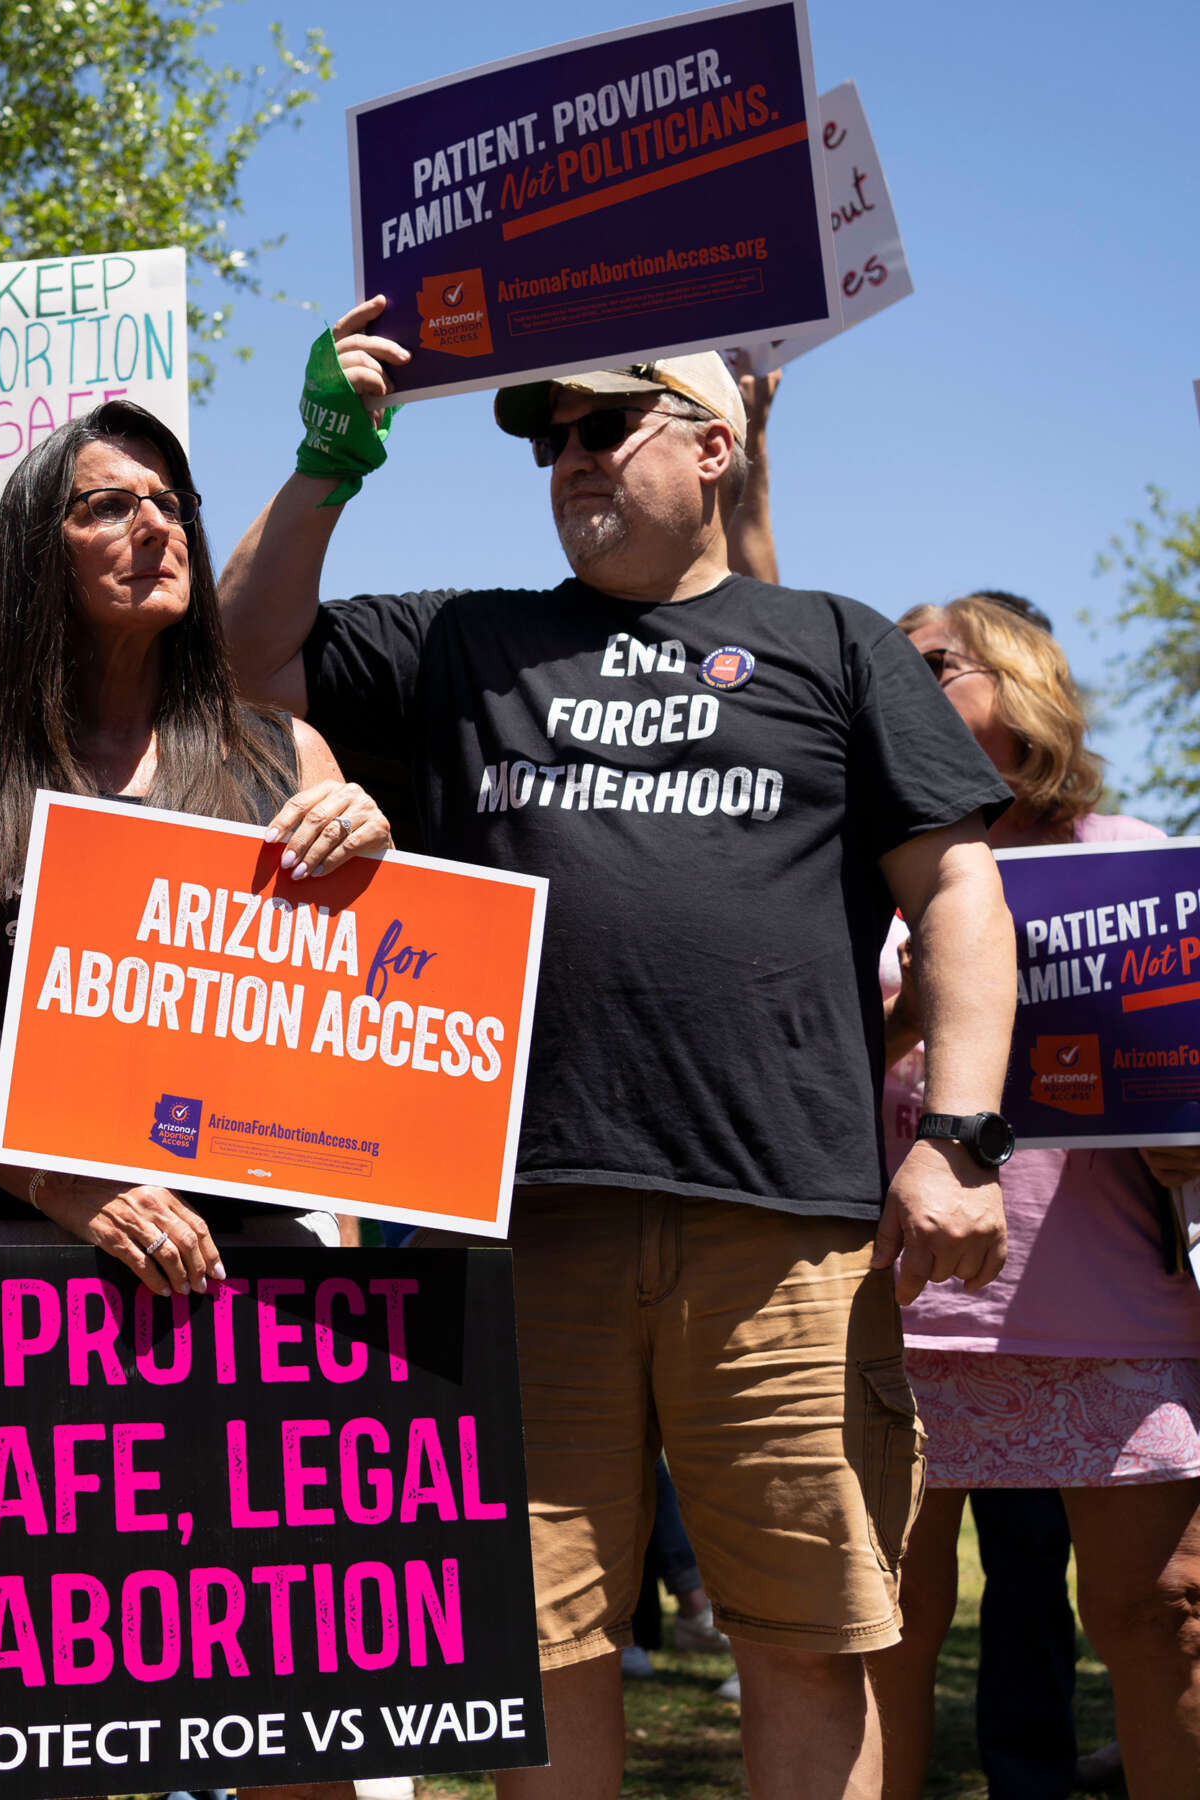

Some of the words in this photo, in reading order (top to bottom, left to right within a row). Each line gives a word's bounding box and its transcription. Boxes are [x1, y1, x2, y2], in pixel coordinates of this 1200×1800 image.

[413, 113, 546, 199] PATIENT.
[552, 49, 731, 144] PROVIDER.
[381, 182, 492, 259] FAMILY.
[500, 165, 556, 211] Not
[557, 84, 779, 193] POLITICIANS.
[498, 237, 768, 303] ArizonaForAbortionAccess.org
[428, 312, 475, 329] Arizona
[600, 632, 686, 679] END
[547, 693, 719, 747] FORCED
[477, 759, 783, 822] MOTHERHOOD
[136, 878, 359, 977] ARIZONA
[365, 919, 437, 1002] for
[1026, 897, 1168, 958] PATIENT.
[1120, 944, 1177, 985] Not
[36, 946, 304, 1050] ABORTION
[310, 991, 504, 1083] ACCESS
[1040, 1073, 1088, 1084] Arizona
[157, 1123, 191, 1134] Arizona
[159, 1131, 194, 1141] Abortion
[162, 1138, 190, 1148] Access
[208, 1113, 380, 1157] ArizonaForAbortionAccess.org
[2, 1277, 418, 1387] PROTECT
[226, 1415, 507, 1529] LEGAL
[180, 1713, 286, 1760] ROE
[303, 1708, 364, 1752] VS
[381, 1698, 526, 1747] WADE
